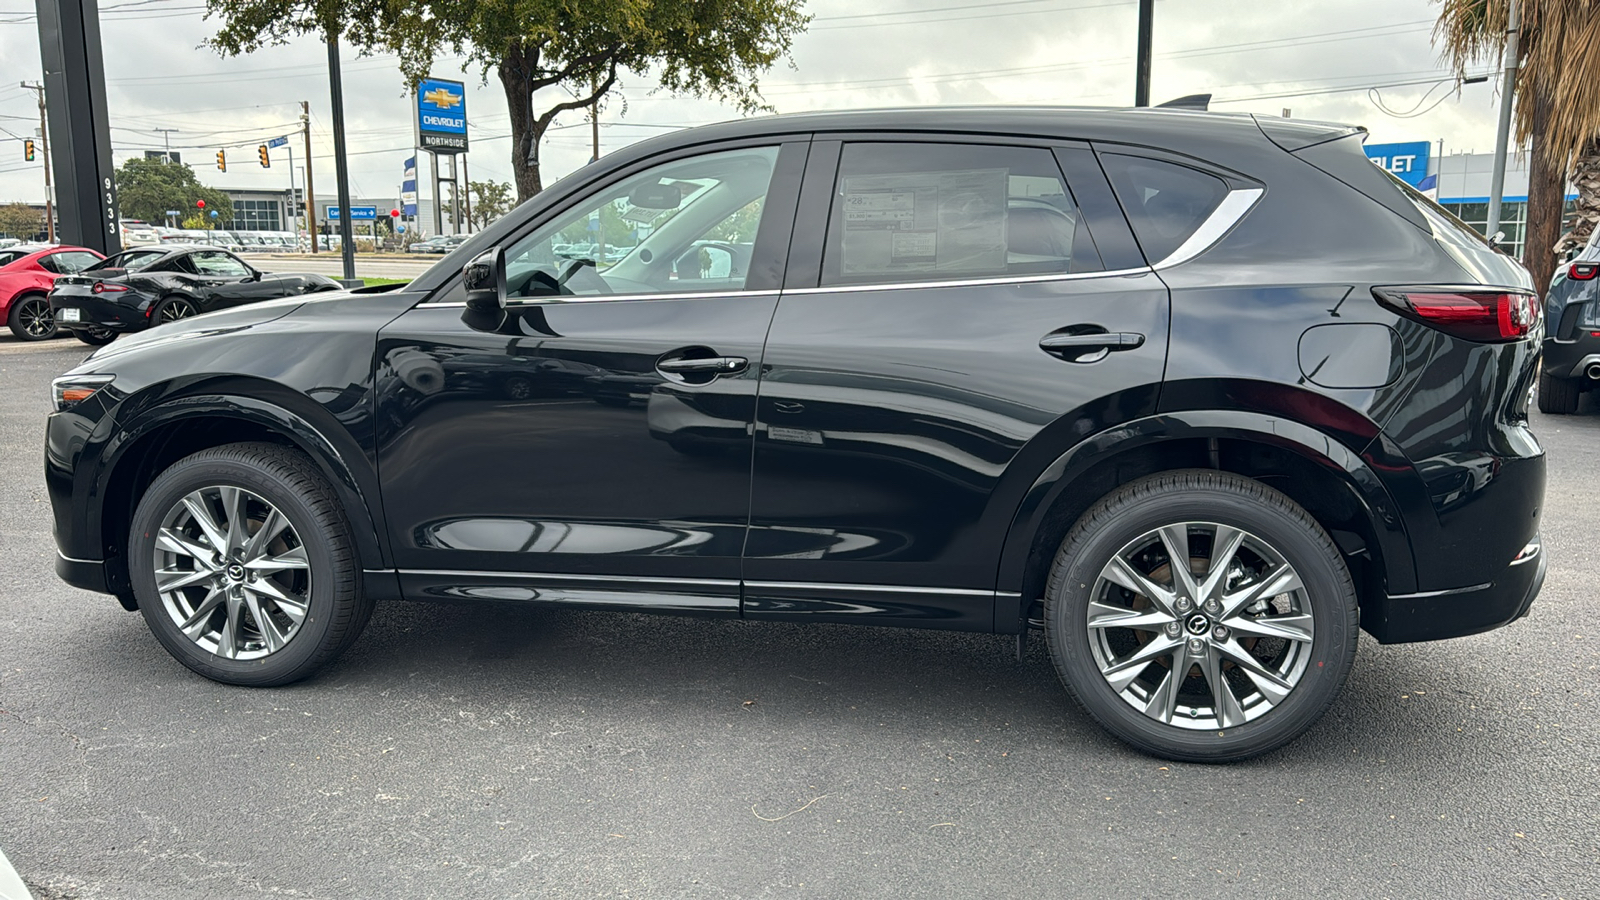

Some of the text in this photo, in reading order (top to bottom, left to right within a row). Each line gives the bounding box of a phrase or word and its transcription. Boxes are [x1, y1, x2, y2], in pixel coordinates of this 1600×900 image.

[423, 115, 464, 128] CHEVROLET
[425, 136, 465, 147] NORTHSIDE
[104, 177, 116, 234] 9333
